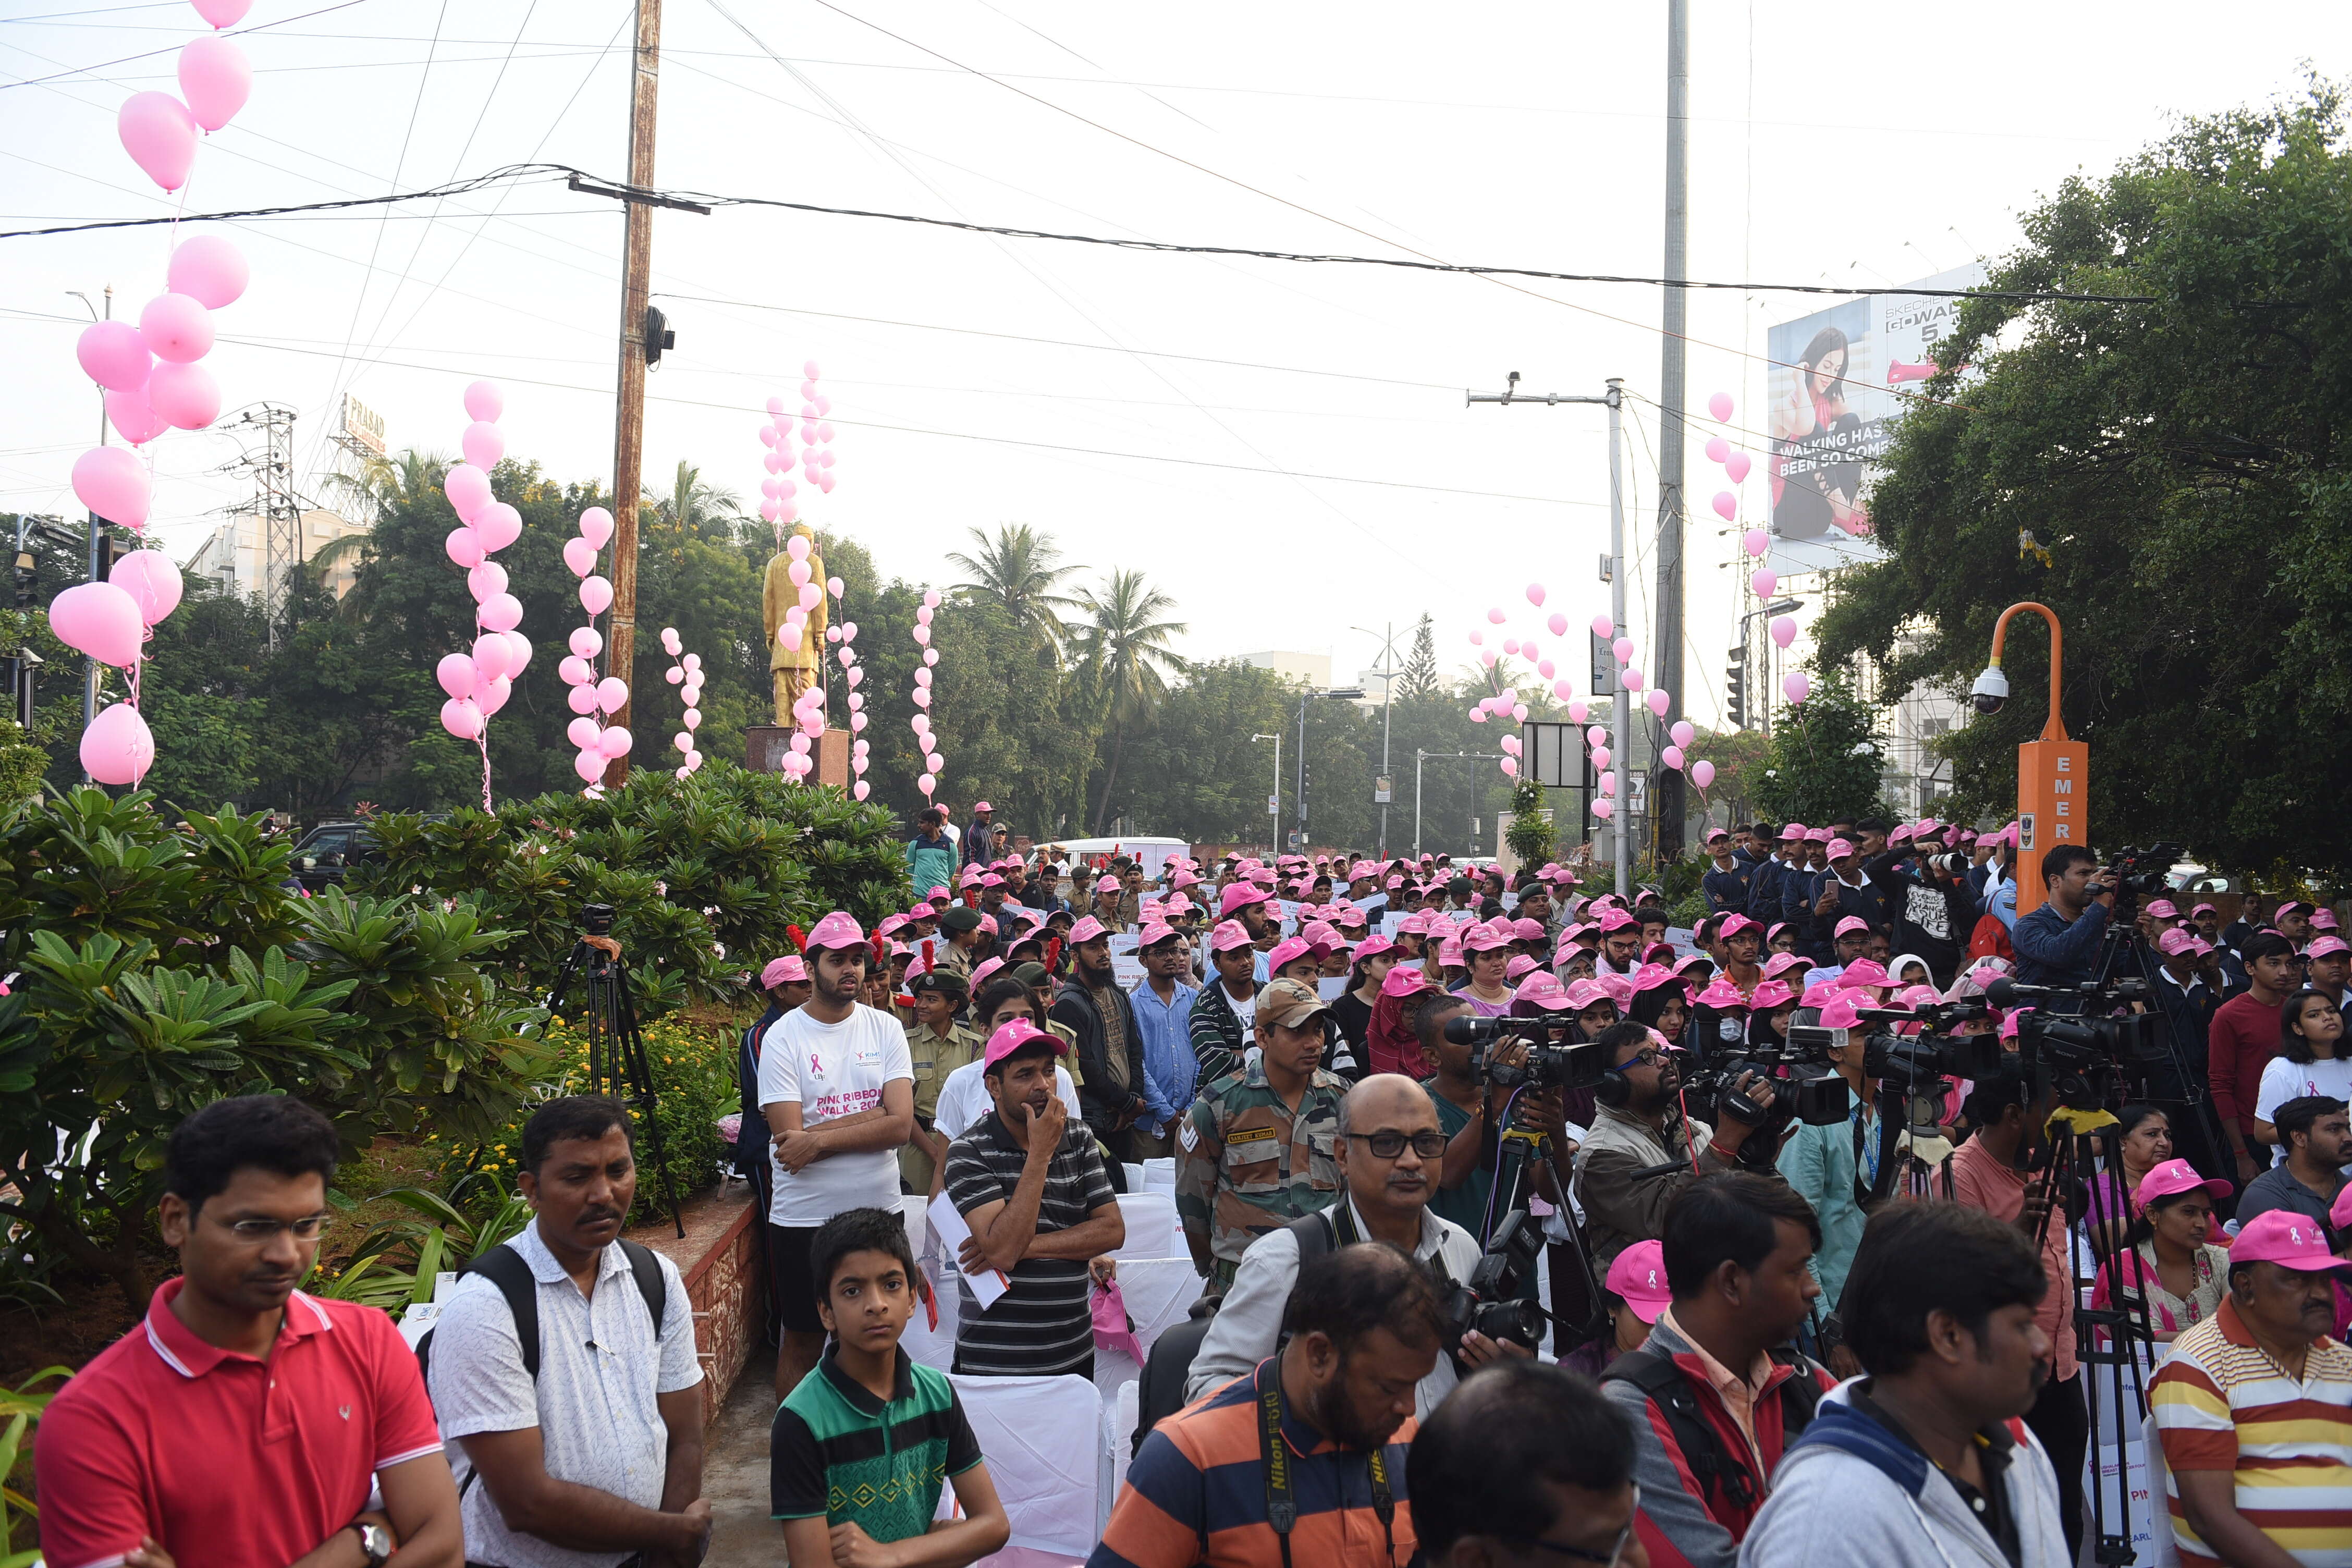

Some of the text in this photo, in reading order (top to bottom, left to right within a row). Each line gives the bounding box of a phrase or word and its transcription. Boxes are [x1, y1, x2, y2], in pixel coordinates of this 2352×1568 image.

[1885, 295, 1956, 318] SKECHE
[1921, 323, 1938, 342] 5
[351, 397, 384, 438] PRASAD
[1780, 424, 1882, 460] WALKING HAS
[1780, 456, 1817, 476] BEEN
[1821, 451, 1841, 467] SO
[2054, 757, 2072, 839] EMER
[2055, 1049, 2079, 1059] SONY
[817, 1095, 840, 1107] PINK
[818, 1104, 851, 1116] WALK
[1730, 1098, 1751, 1113] Panasonic
[1271, 1439, 1286, 1490] Nikon
[1370, 1449, 1385, 1484] Nik
